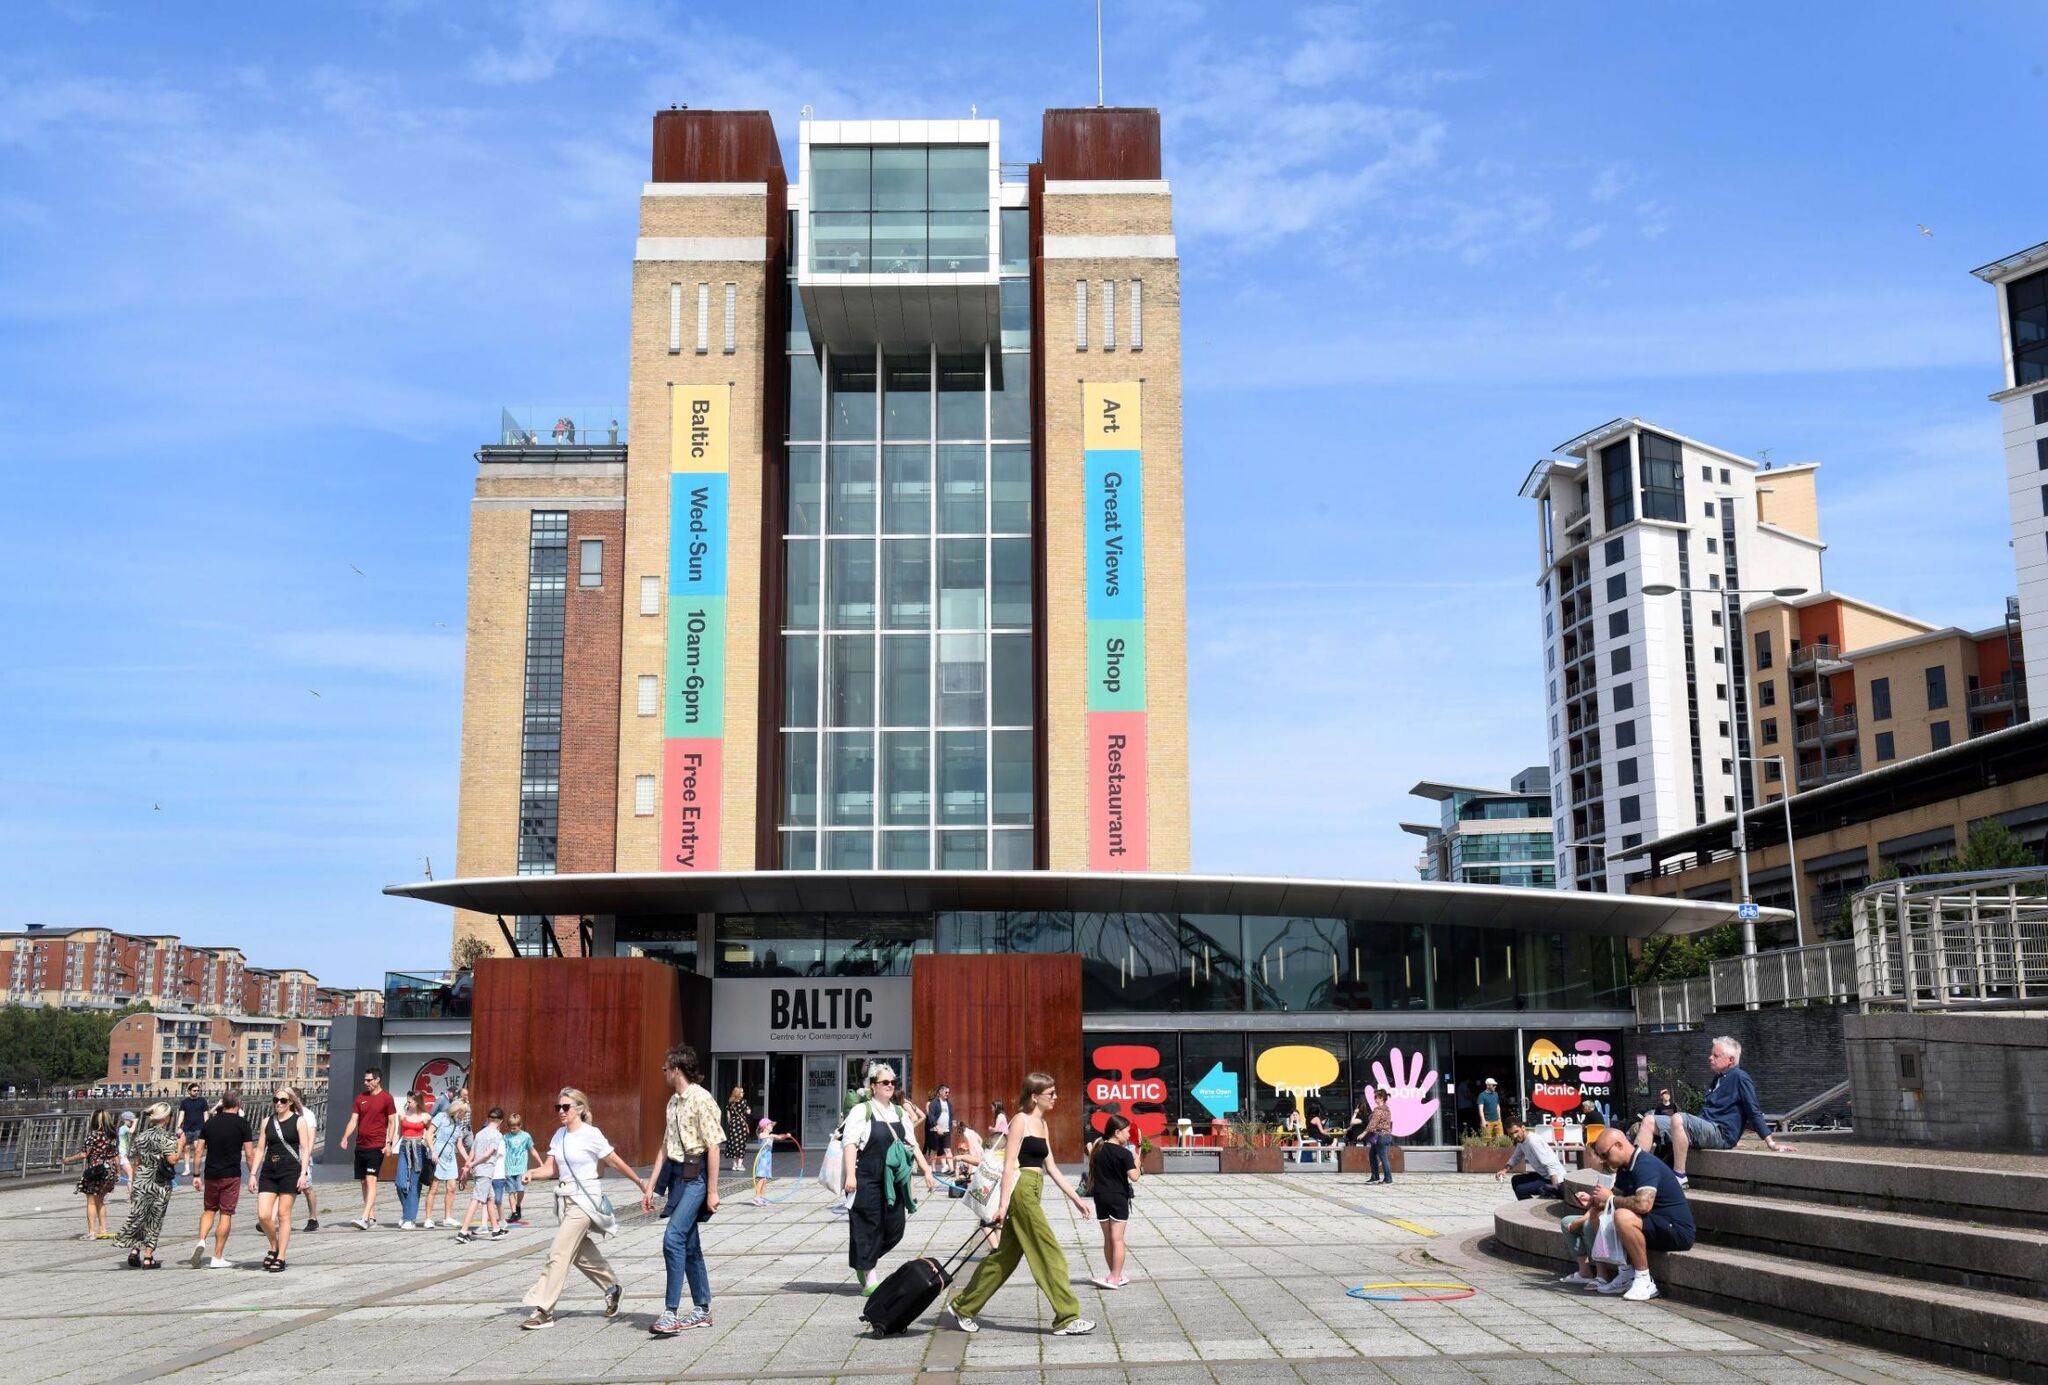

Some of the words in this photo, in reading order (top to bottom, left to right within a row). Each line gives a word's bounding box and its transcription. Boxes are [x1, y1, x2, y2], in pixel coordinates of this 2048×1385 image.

[691, 400, 710, 458] Baltic
[1103, 399, 1121, 433] Art
[1104, 472, 1122, 531] Great
[689, 487, 708, 581] Wed-Sun
[1105, 535, 1123, 597] Views
[681, 609, 706, 723] 10am-6pm
[1103, 638, 1125, 693] Shop
[682, 753, 702, 802] Free
[1107, 735, 1126, 857] Restaurant
[676, 806, 701, 867] Entry
[770, 988, 873, 1030] BALTIC
[770, 1032, 795, 1041] Centre
[797, 1032, 807, 1040] for
[808, 1032, 860, 1041] Contemporary
[861, 1031, 873, 1040] Art
[444, 1075, 460, 1087] THE
[1531, 1053, 1606, 1066] Exhibitions
[1096, 1083, 1160, 1100] BALTIC
[1275, 1082, 1321, 1098] Front
[1534, 1083, 1575, 1096] Picnic
[1578, 1083, 1610, 1096] Area
[1542, 1113, 1574, 1125] Free
